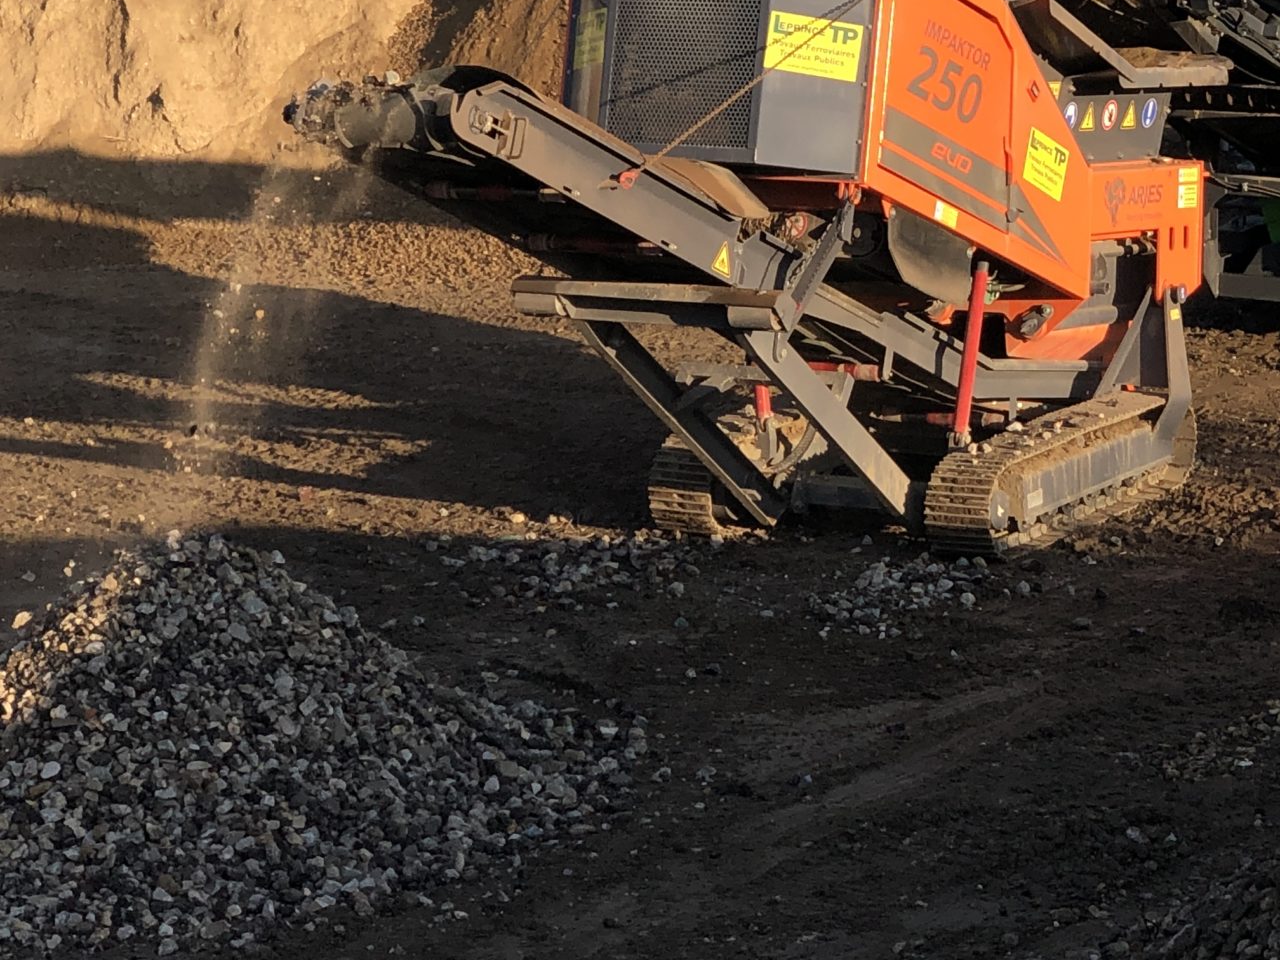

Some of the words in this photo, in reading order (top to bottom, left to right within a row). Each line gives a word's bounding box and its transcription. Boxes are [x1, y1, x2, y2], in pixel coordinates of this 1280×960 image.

[829, 24, 859, 45] TP
[924, 19, 991, 72] IMPAKTOR
[813, 54, 845, 67] Publics
[906, 44, 983, 124] 250
[1054, 146, 1067, 167] TP
